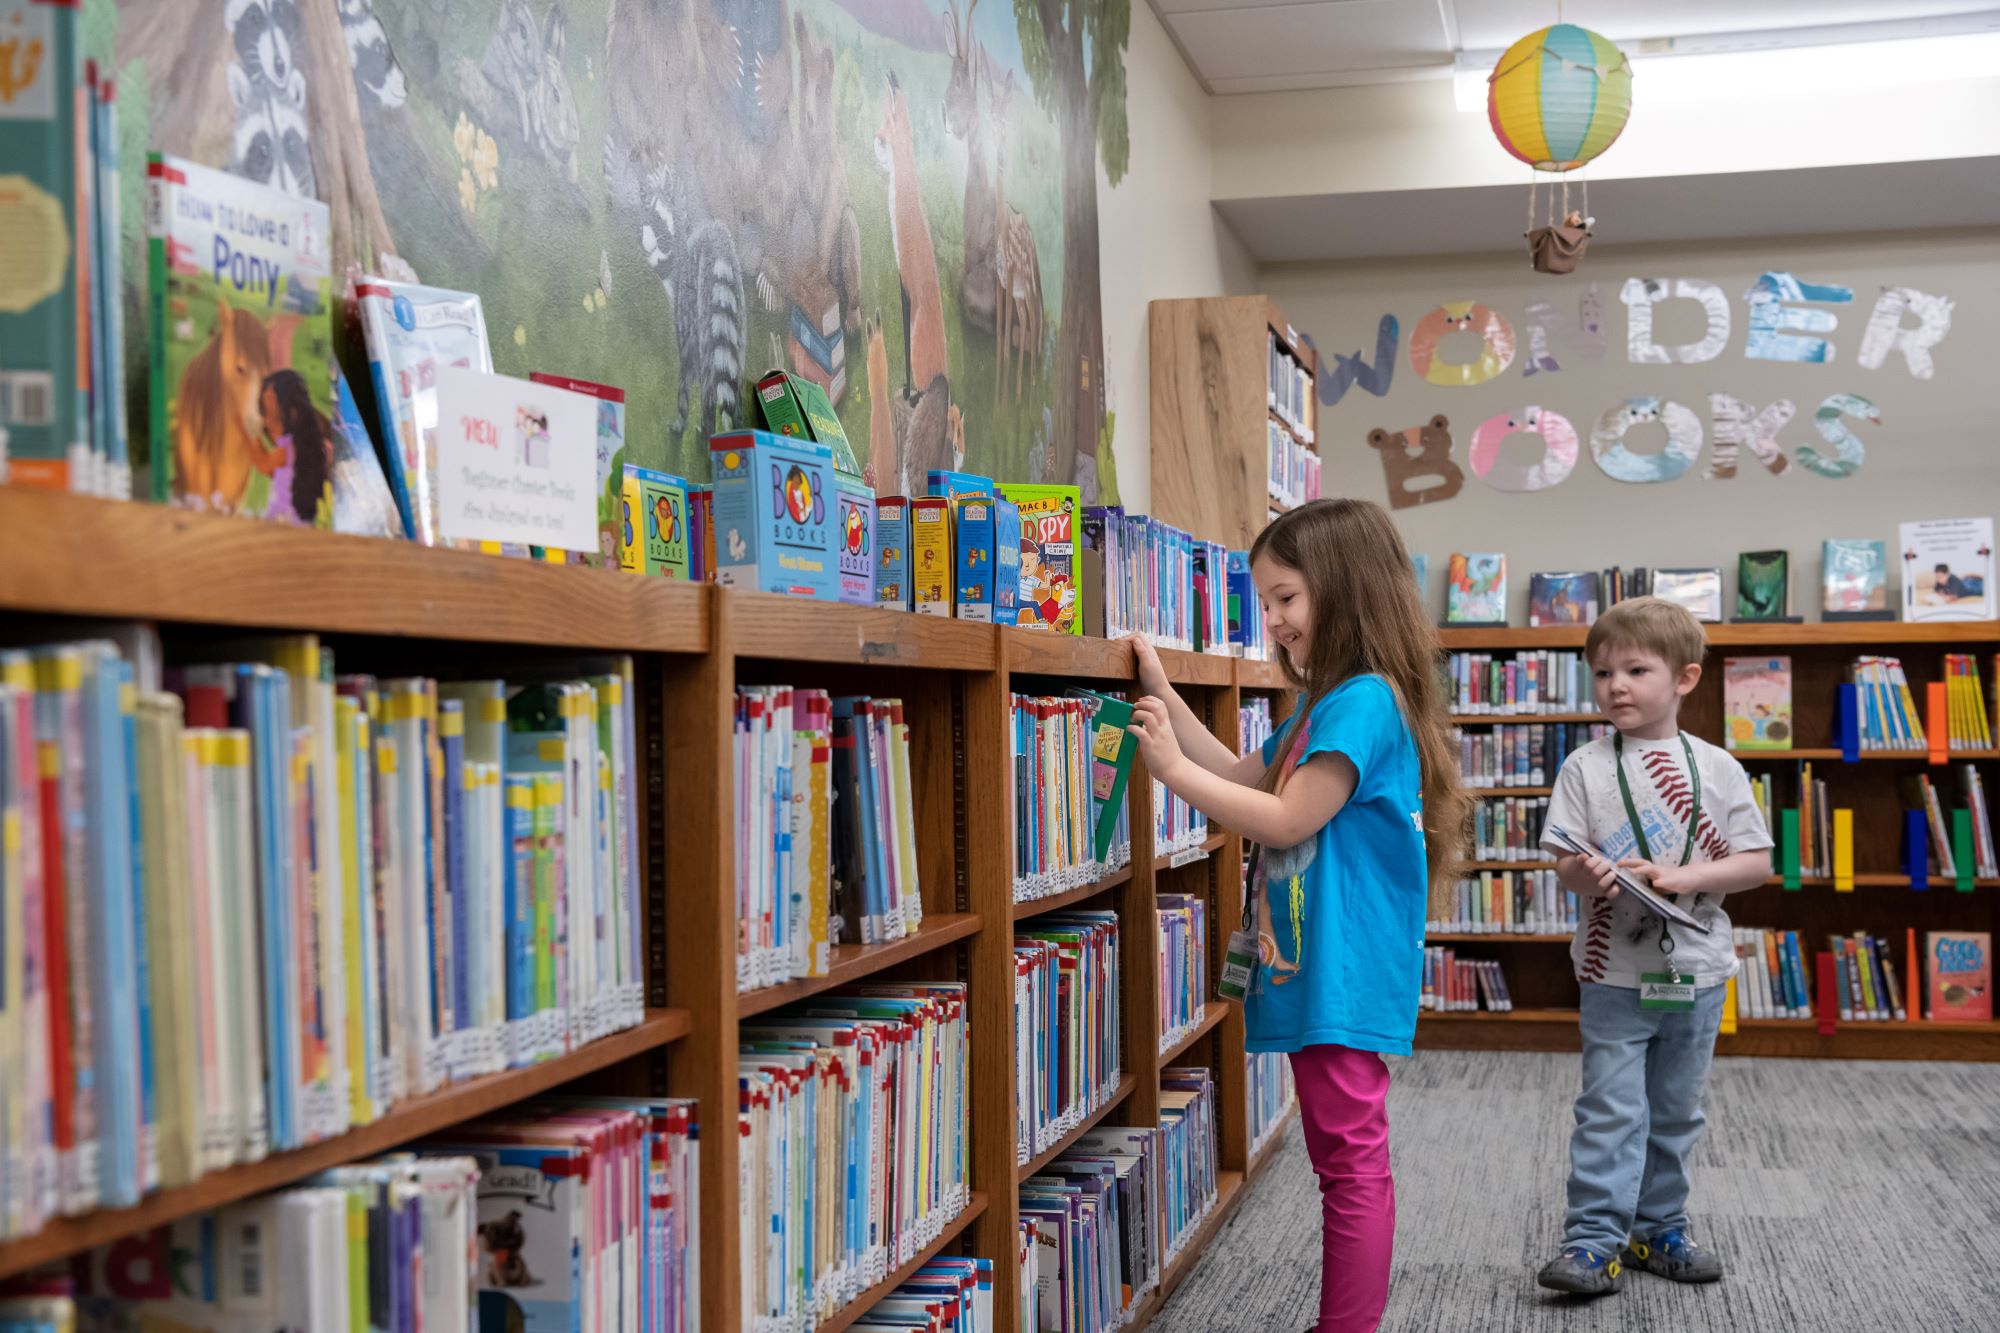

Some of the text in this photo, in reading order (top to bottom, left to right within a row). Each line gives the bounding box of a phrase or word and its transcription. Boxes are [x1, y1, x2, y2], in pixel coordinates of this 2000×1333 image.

[213, 233, 280, 308] Pony
[1301, 271, 1955, 406] WONDER
[460, 415, 499, 450] NEW
[1367, 391, 1881, 510] BOOKS
[771, 464, 825, 526] BOB
[1017, 501, 1040, 513] MAC
[648, 494, 682, 545] BOB
[774, 524, 827, 544] BOOKS
[840, 502, 870, 557] BOB
[1039, 516, 1070, 544] SPY
[650, 543, 683, 560] BOOKS
[840, 556, 870, 573] BOOKS
